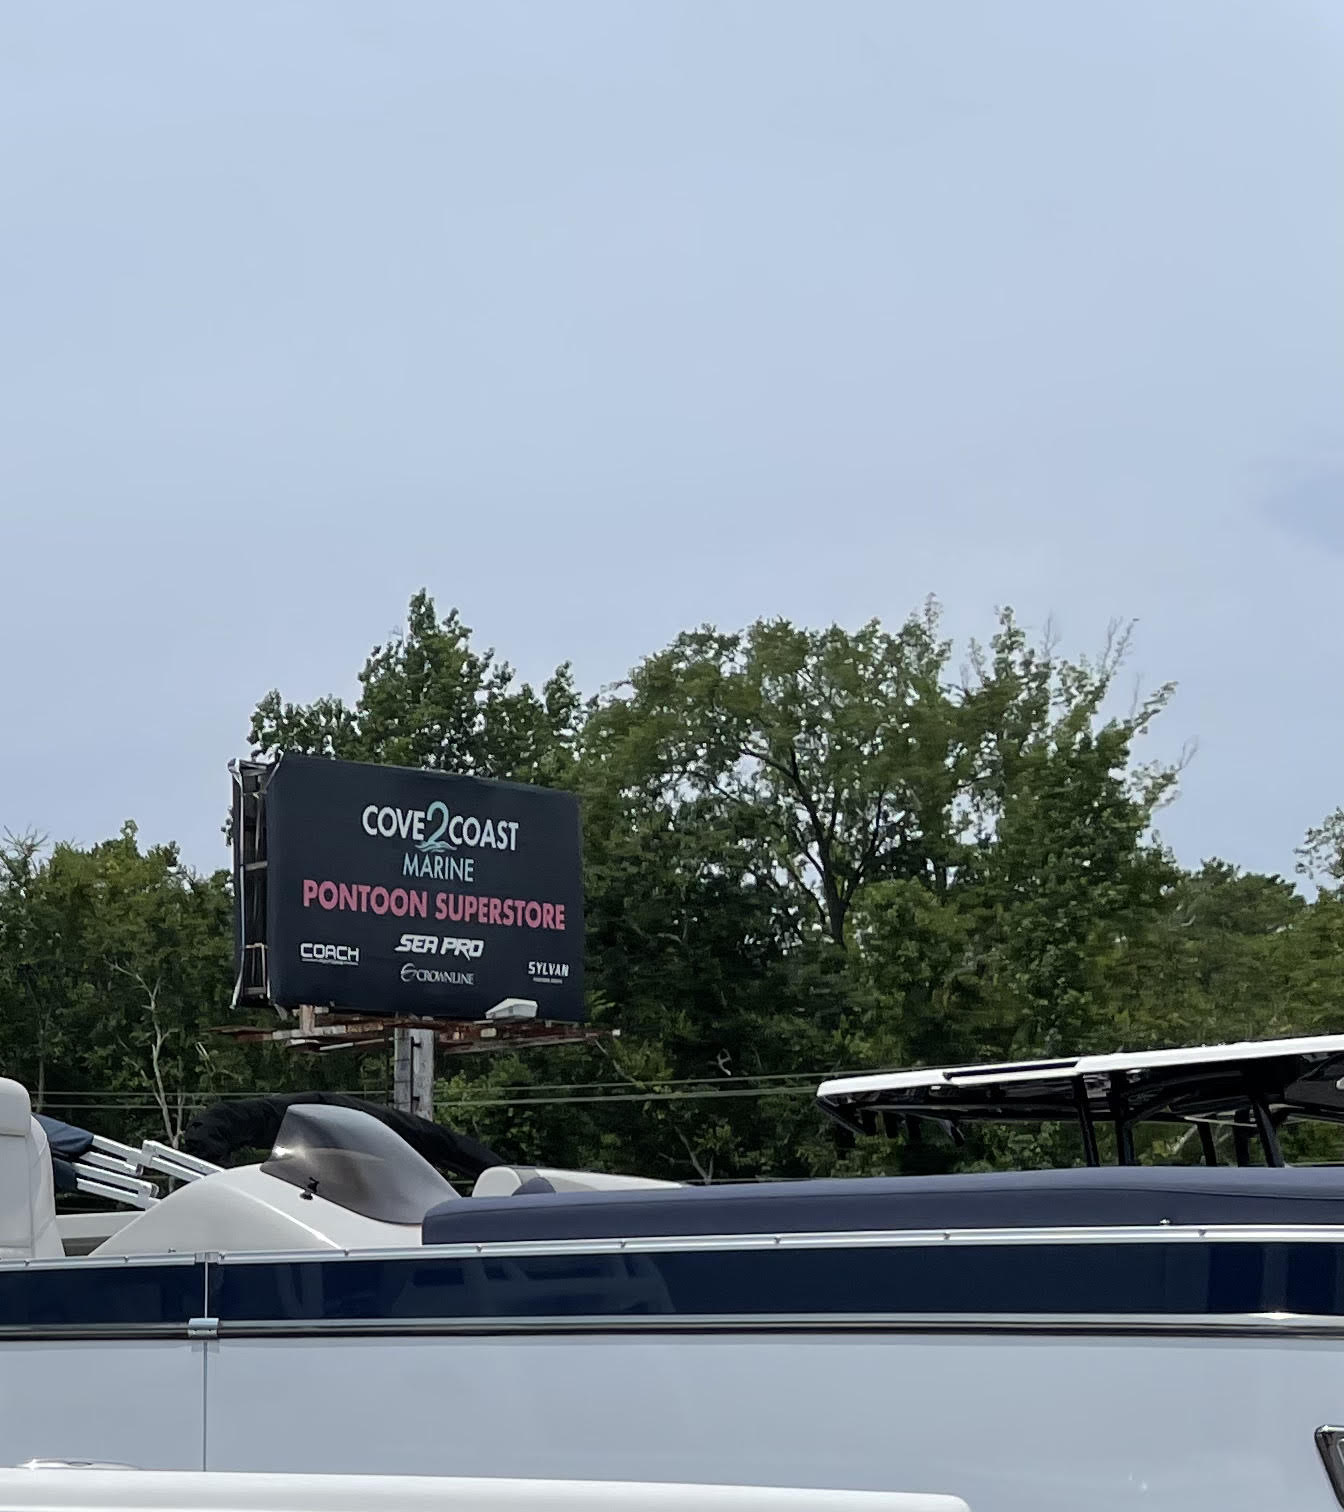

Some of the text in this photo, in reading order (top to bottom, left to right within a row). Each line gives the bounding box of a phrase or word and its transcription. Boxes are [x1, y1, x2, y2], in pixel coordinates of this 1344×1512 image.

[402, 853, 474, 882] MARINE
[303, 880, 566, 931] PONTOON SUPERSTORE
[300, 942, 359, 962] COACH
[394, 934, 485, 961] SEA PRO
[528, 961, 569, 977] SYLVAN
